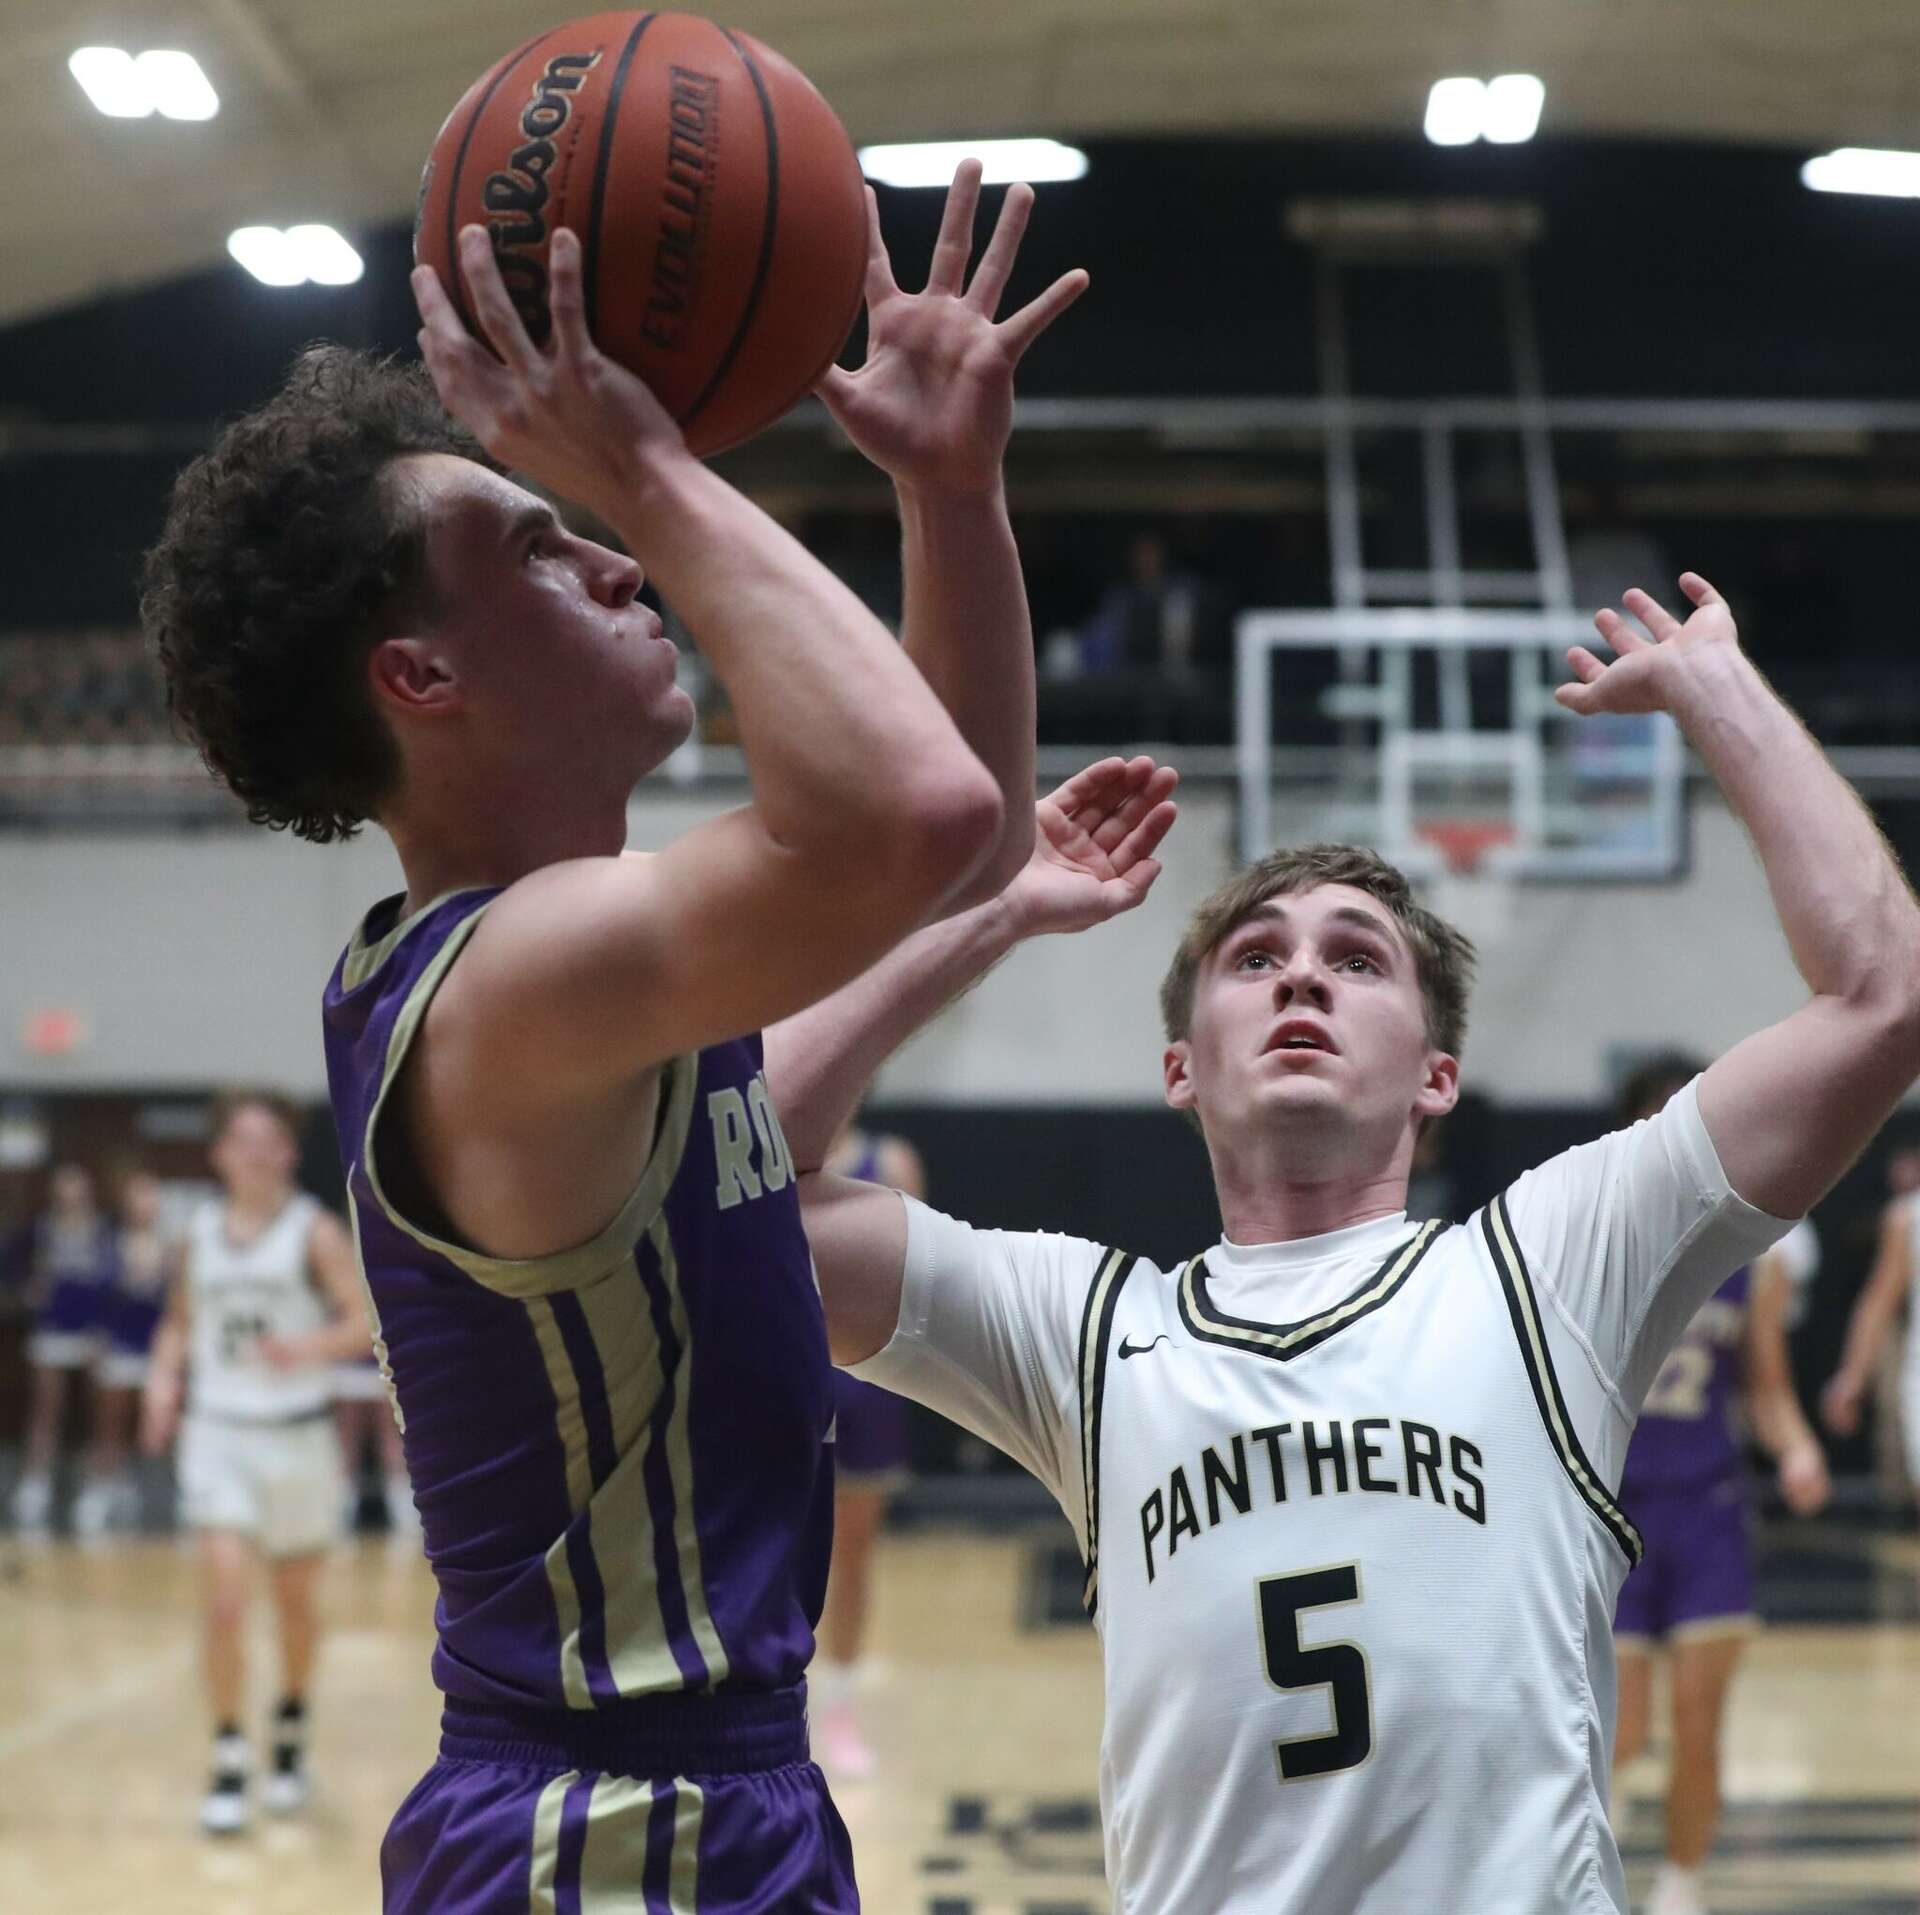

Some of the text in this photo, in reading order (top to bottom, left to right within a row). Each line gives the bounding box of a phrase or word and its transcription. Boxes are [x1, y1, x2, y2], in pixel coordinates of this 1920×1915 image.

[639, 65, 706, 349] EVOLUTION
[707, 1070, 796, 1210] RO
[1139, 1416, 1487, 1584] PANTHERS
[1254, 1560, 1376, 1784] 5
